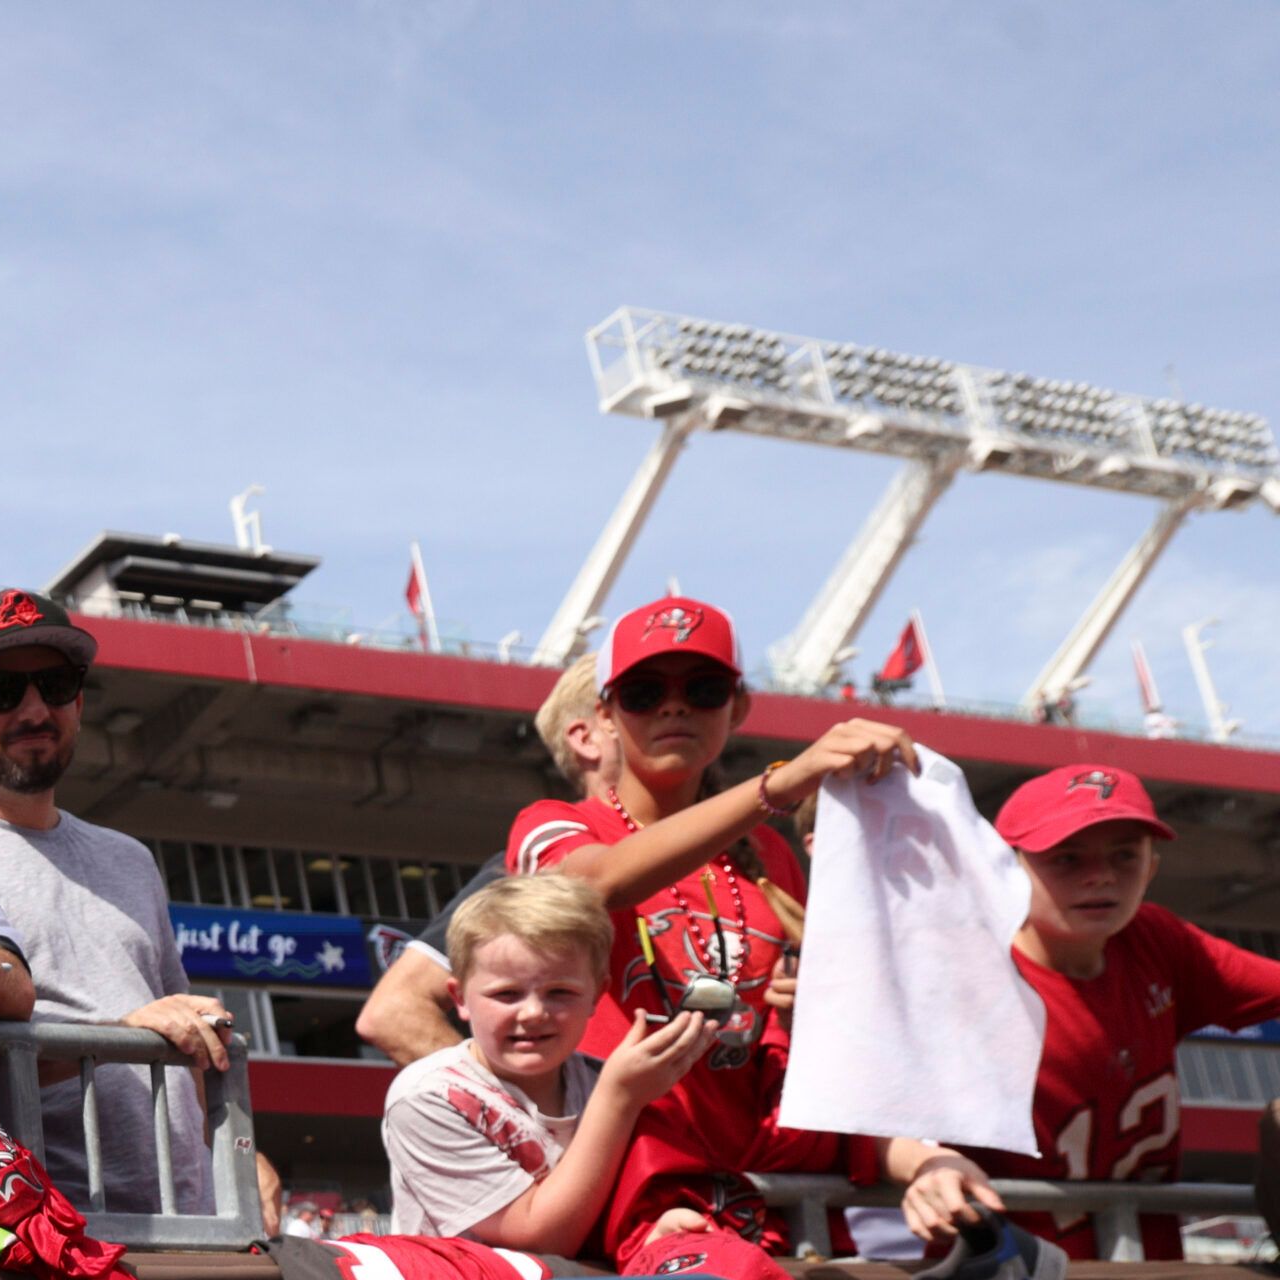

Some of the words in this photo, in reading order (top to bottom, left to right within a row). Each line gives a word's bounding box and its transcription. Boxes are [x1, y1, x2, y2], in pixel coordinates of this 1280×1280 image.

[175, 922, 224, 956] just
[227, 919, 263, 954] let
[267, 934, 298, 967] go
[1051, 1068, 1183, 1233] 12
